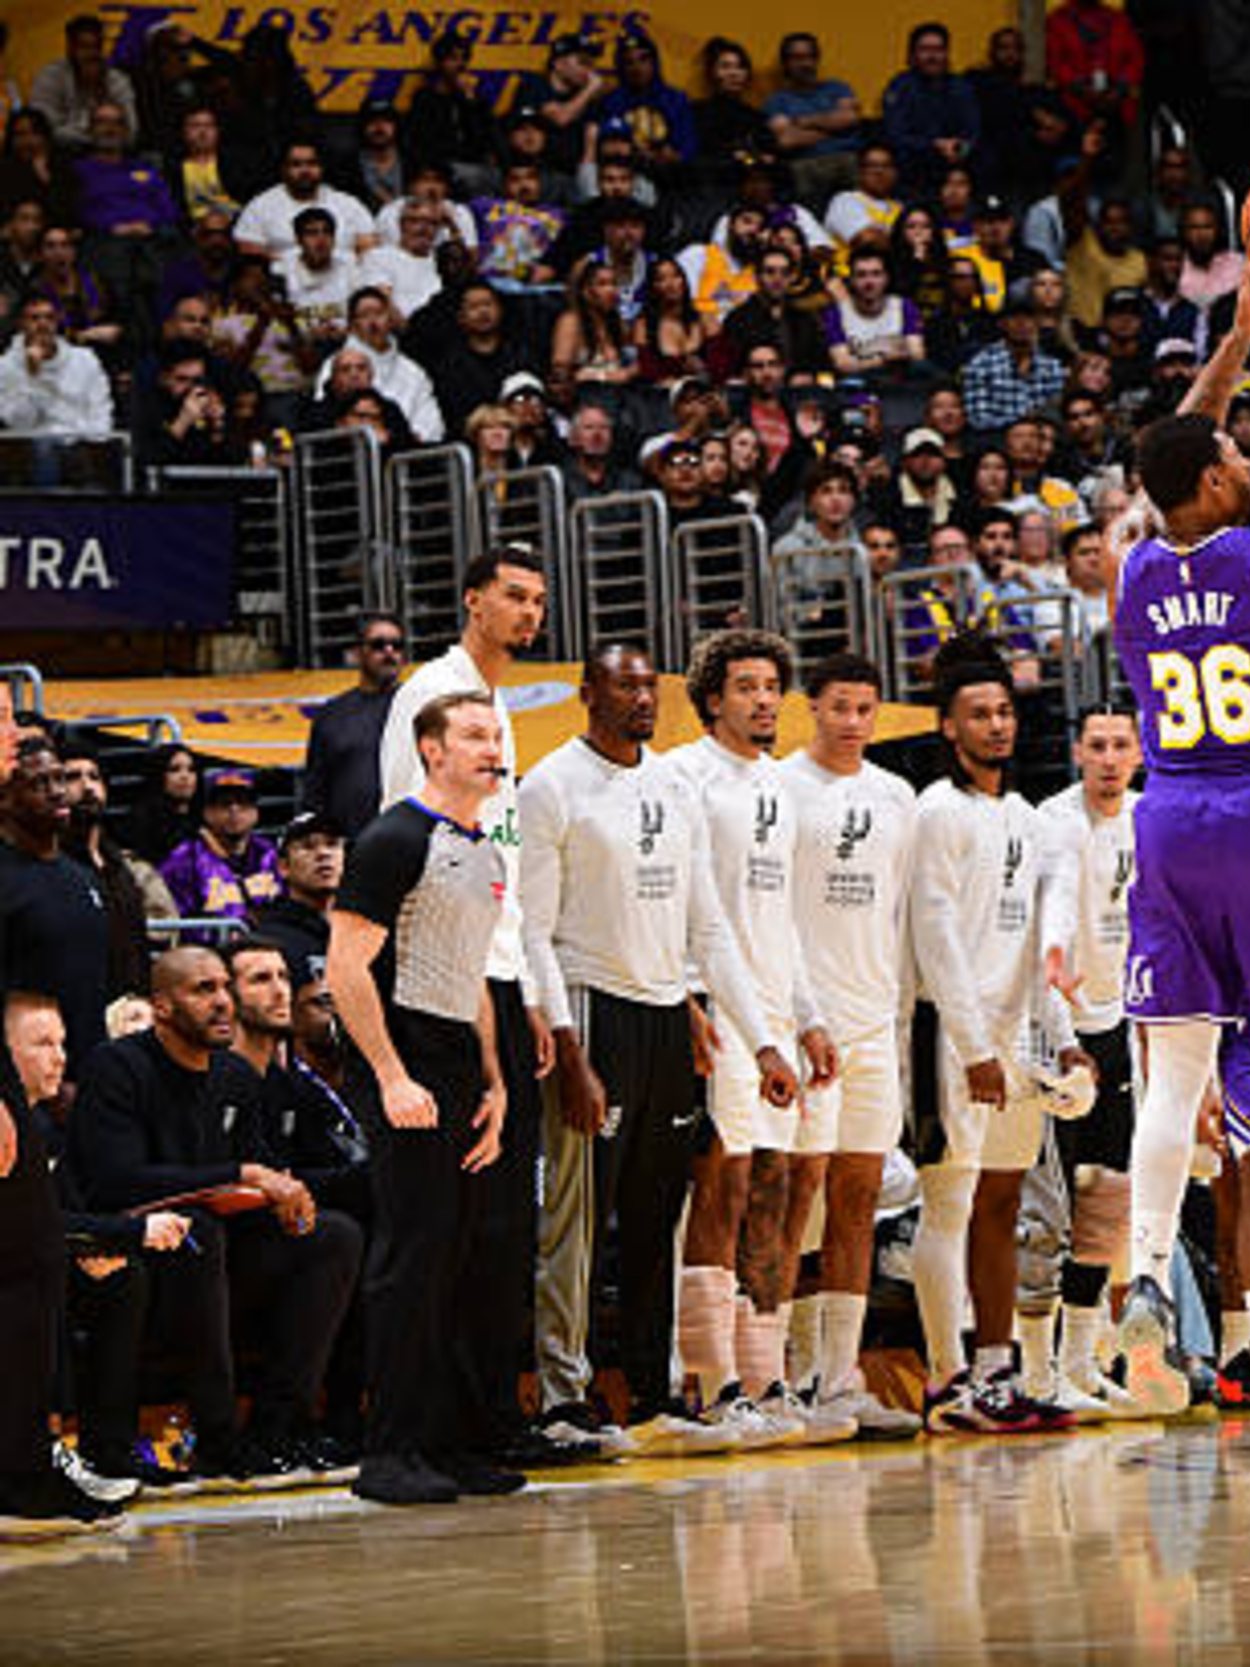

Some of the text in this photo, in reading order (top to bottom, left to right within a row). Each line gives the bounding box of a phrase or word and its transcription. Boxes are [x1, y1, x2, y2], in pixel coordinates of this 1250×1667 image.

[217, 8, 336, 43] LOS
[347, 9, 651, 46] ANGELES
[1148, 592, 1234, 634] SMART
